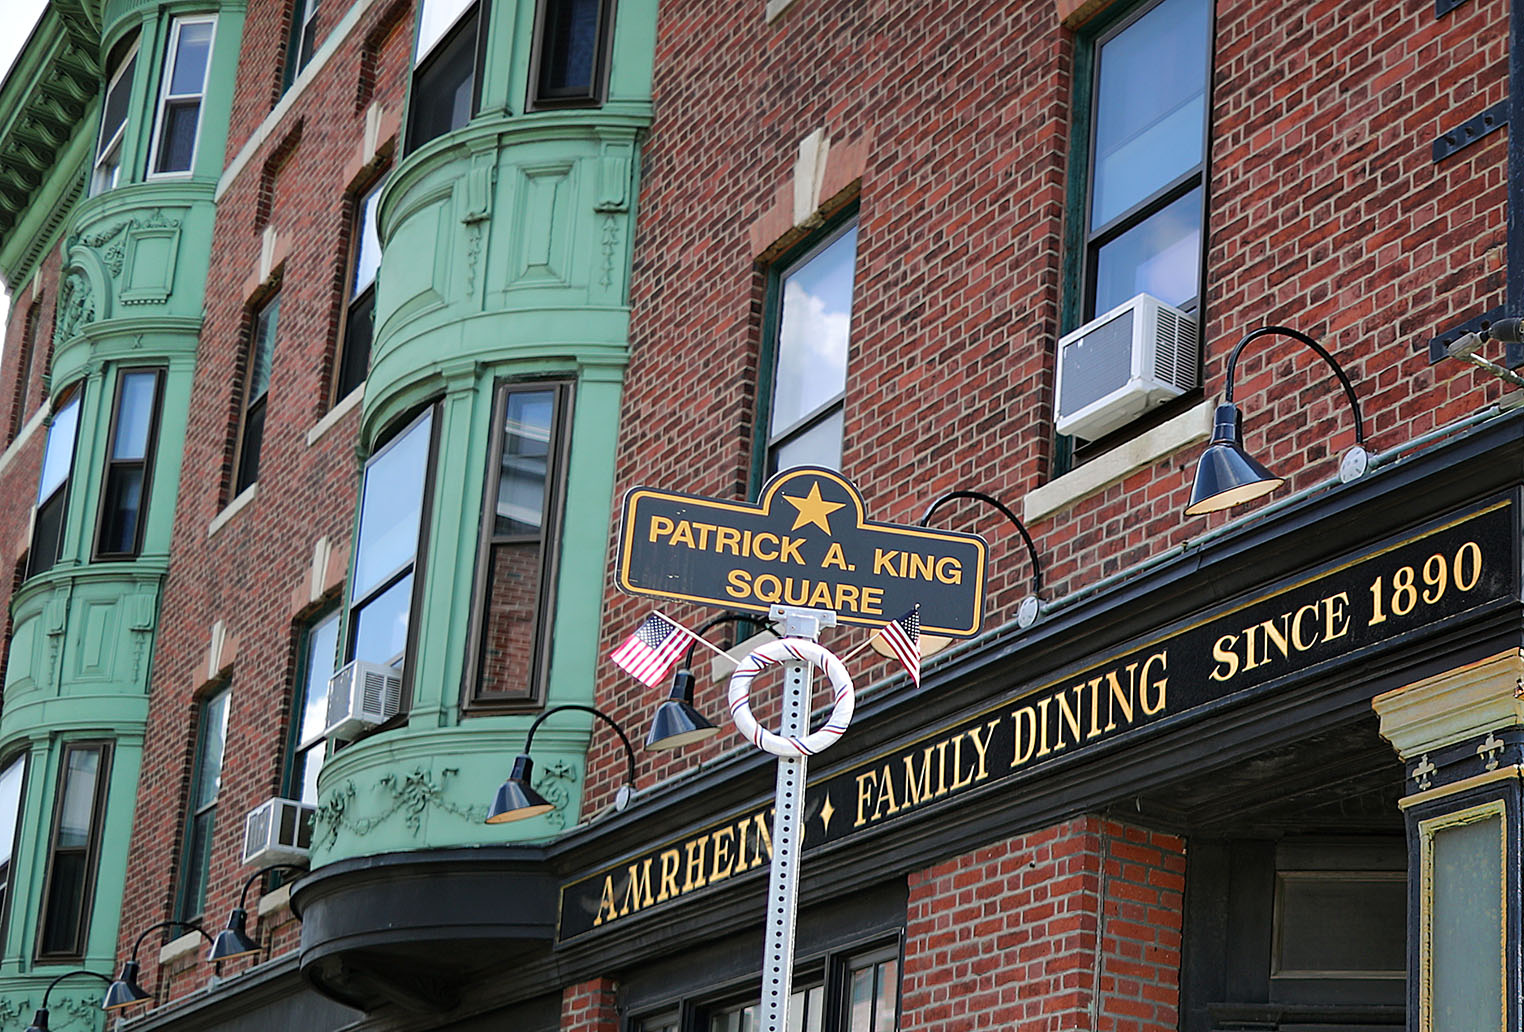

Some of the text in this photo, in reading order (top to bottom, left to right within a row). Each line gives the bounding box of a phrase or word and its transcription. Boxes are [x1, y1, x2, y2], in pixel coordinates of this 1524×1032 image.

[648, 514, 963, 585] PATRICK A. KING
[725, 569, 885, 616] SQUARE
[592, 541, 1483, 927] AMRHEIN FAMILY DINING SINCE 1890
